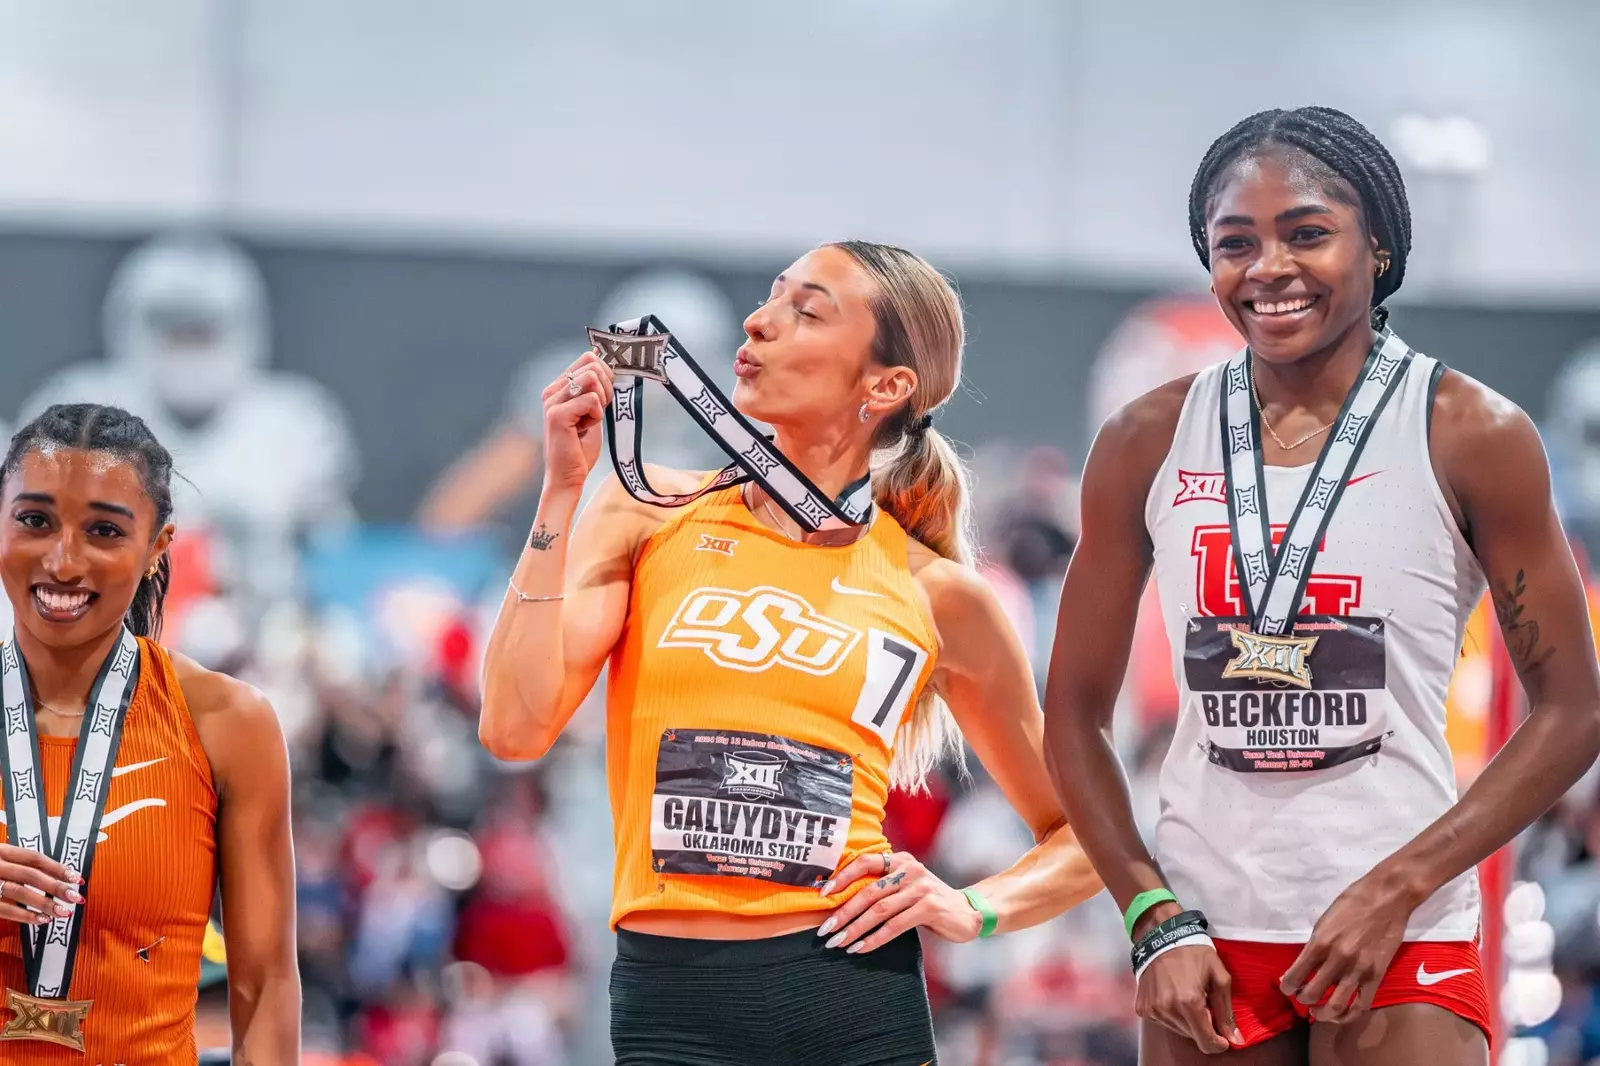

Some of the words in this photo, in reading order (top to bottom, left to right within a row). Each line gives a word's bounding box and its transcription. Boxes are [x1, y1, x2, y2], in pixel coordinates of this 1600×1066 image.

[589, 331, 667, 379] XII
[696, 535, 737, 555] XII
[669, 592, 850, 667] OSU
[1293, 622, 1347, 631] hampionships
[1227, 630, 1315, 685] XII
[871, 636, 917, 728] 7
[1201, 692, 1367, 727] BECKFORD
[1247, 729, 1319, 746] HOUSTON
[1286, 749, 1325, 760] University
[723, 755, 785, 793] XII
[663, 797, 837, 848] GALVYDYTE
[683, 832, 764, 856] OKLAHOMA
[768, 841, 812, 862] STATE
[1151, 937, 1165, 950] YOU
